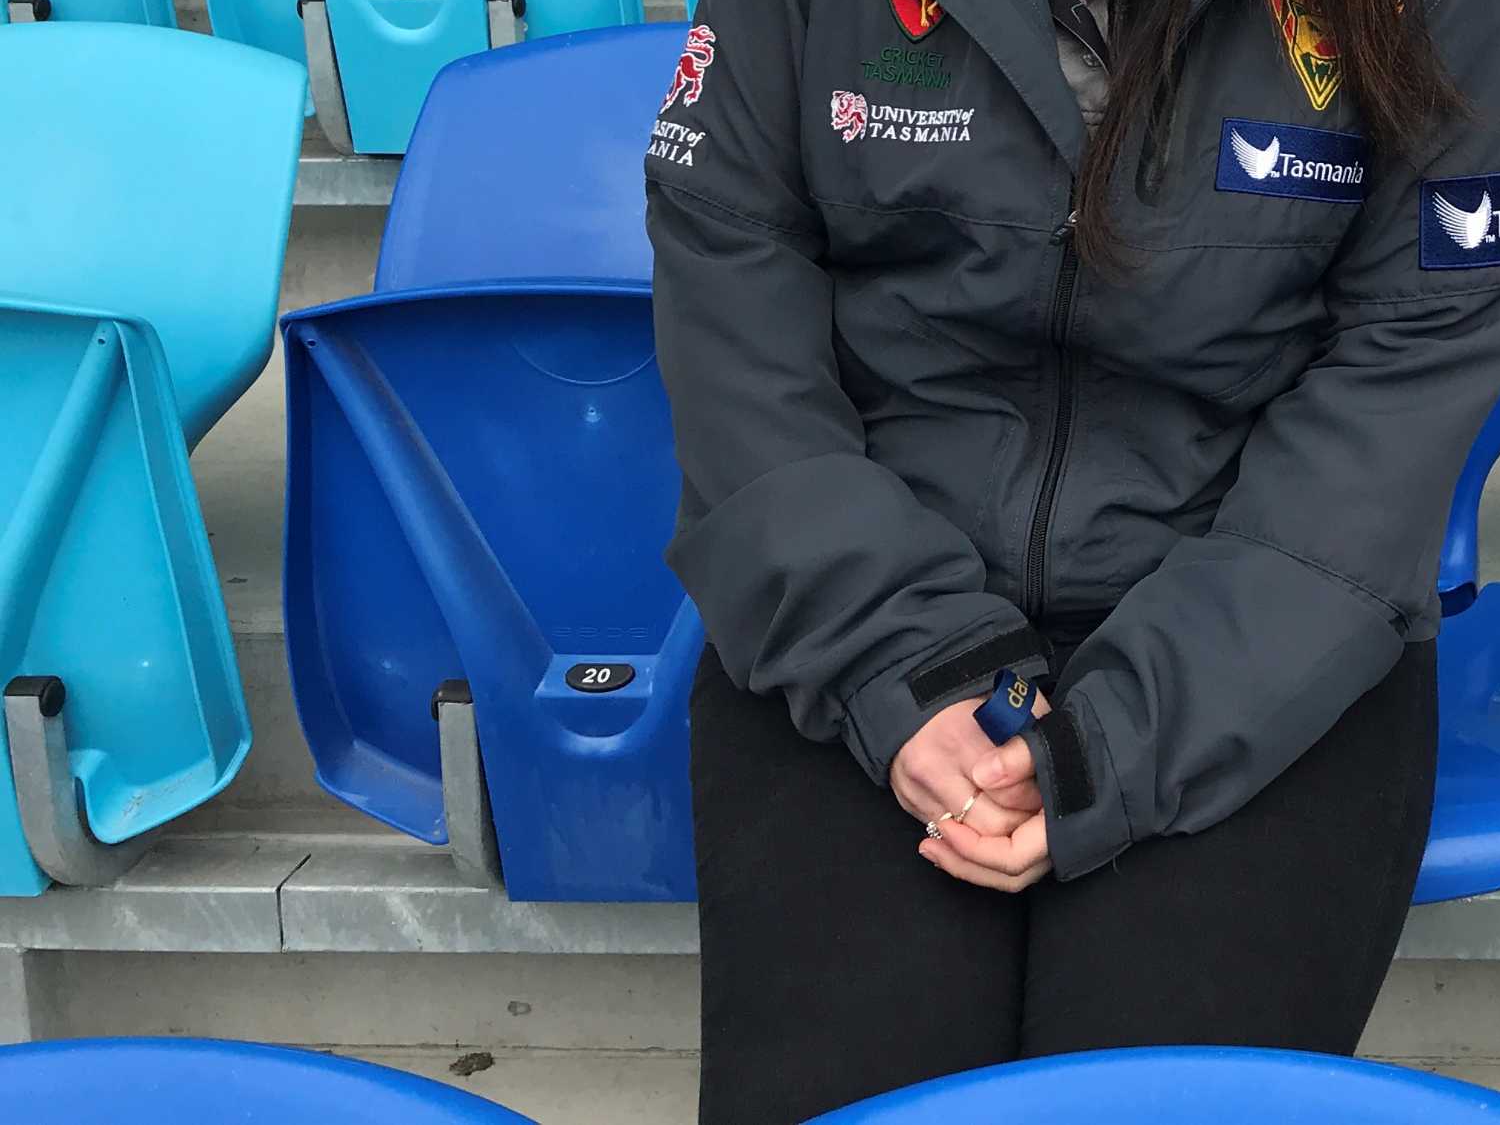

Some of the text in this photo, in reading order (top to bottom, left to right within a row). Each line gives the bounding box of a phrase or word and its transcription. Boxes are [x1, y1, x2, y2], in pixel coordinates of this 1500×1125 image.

[880, 46, 945, 68] CRICKET
[870, 123, 971, 142] TASMANIA
[1280, 152, 1364, 184] Tasmania
[581, 668, 611, 683] 20
